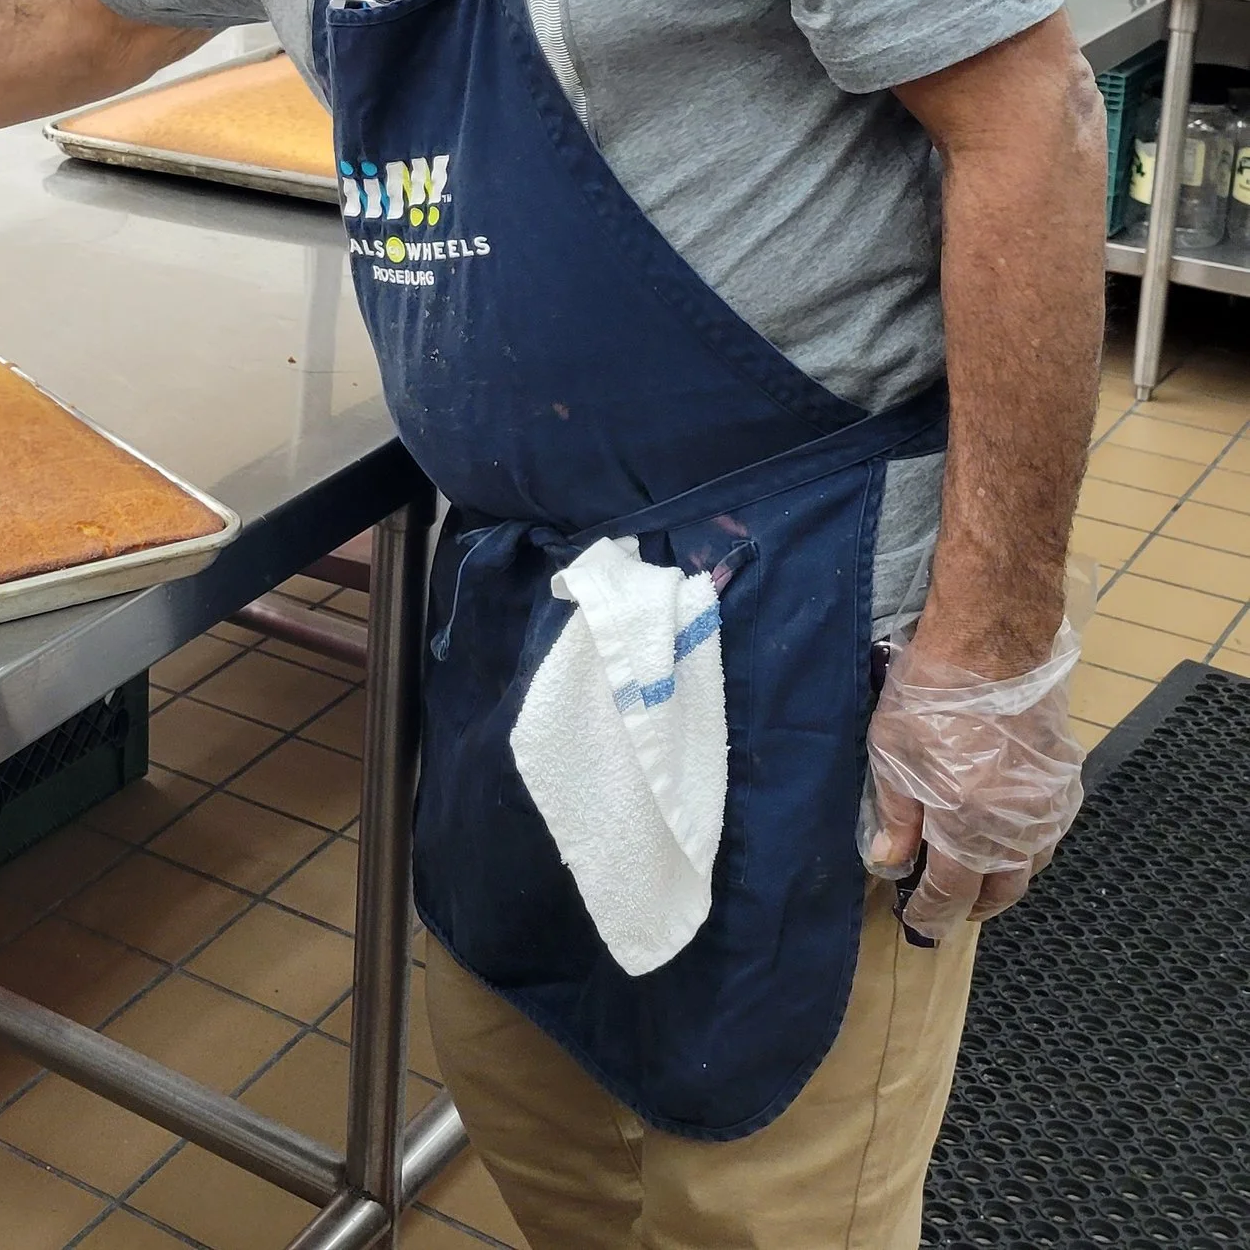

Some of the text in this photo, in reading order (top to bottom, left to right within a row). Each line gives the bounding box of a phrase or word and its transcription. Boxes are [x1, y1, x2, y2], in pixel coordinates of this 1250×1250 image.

[350, 238, 385, 258] ALS
[405, 236, 491, 261] WHEELS
[373, 265, 435, 286] ROSEBURG
